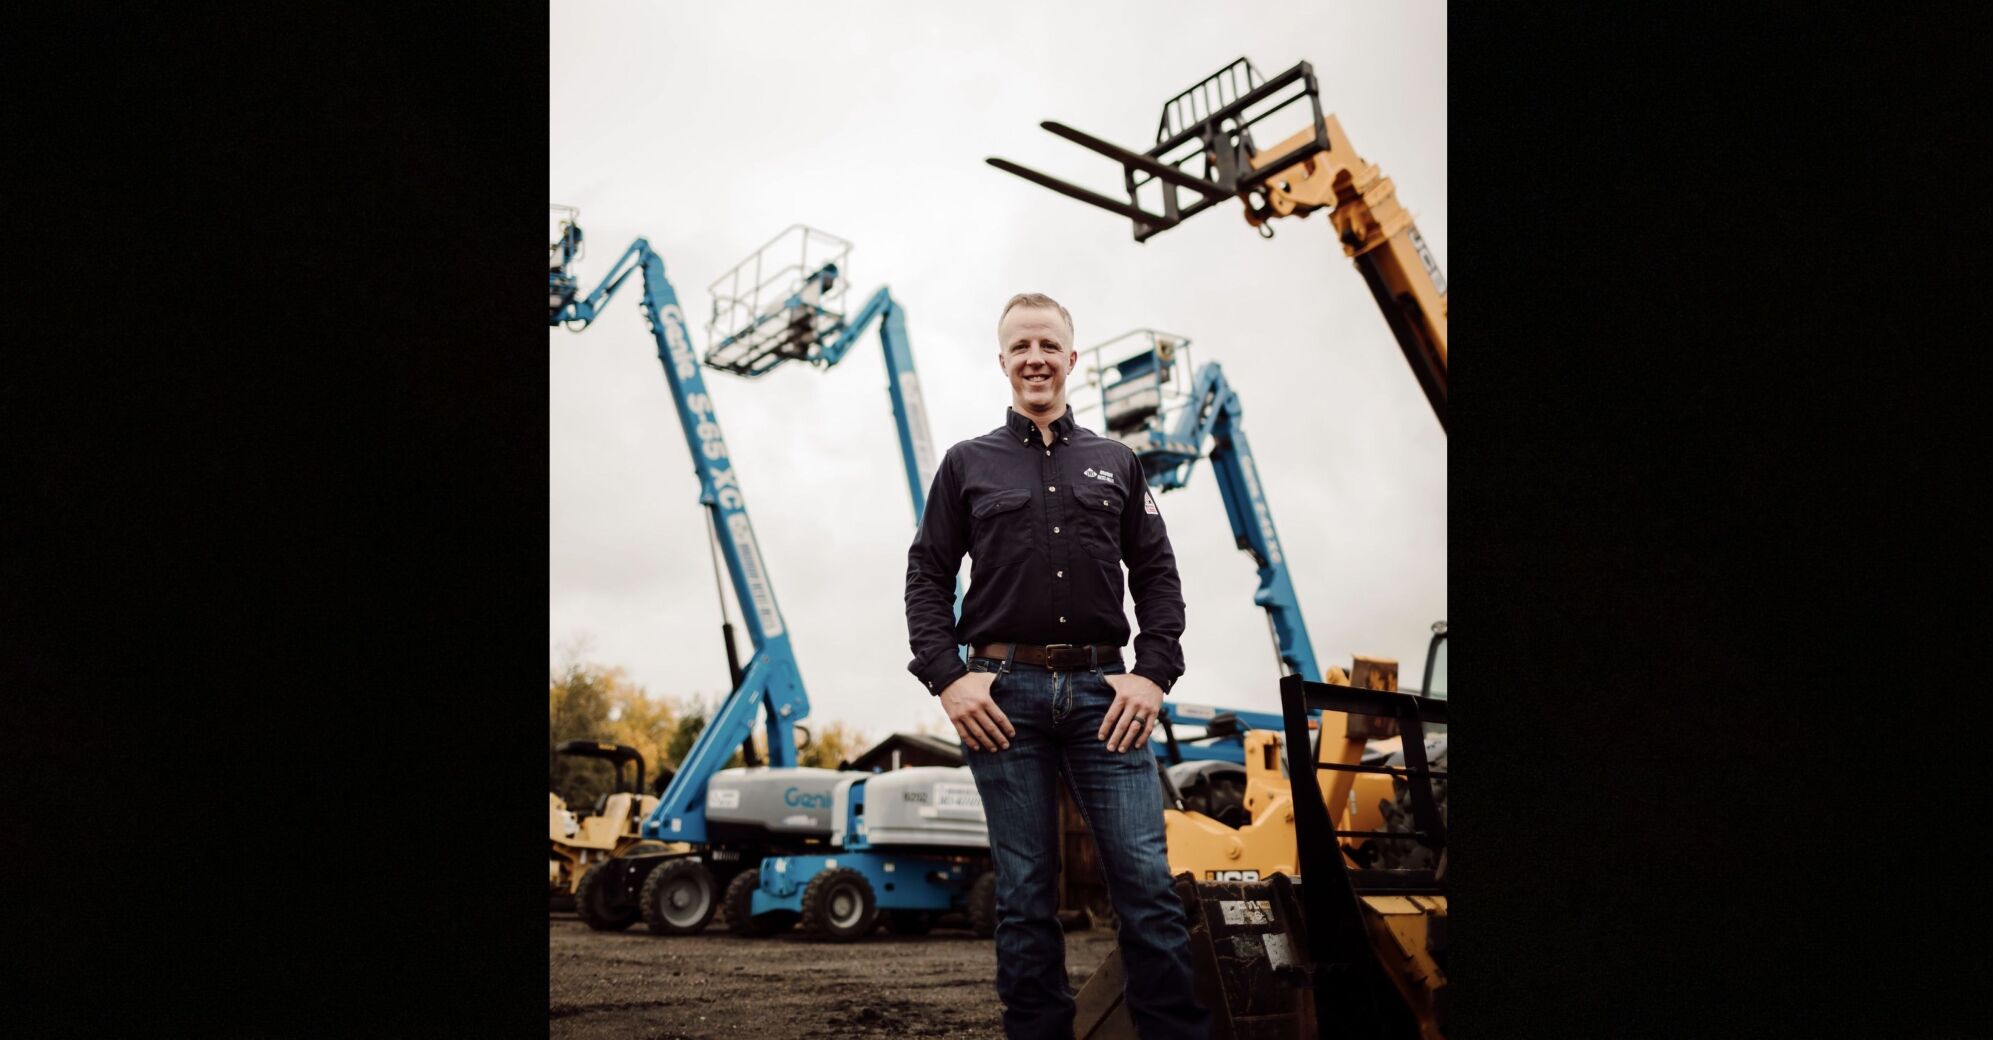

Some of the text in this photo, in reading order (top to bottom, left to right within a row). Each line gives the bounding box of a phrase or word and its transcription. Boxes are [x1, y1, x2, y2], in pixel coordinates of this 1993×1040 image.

[661, 304, 695, 383] Genie
[687, 393, 728, 461] S-65
[709, 466, 743, 509] XC
[784, 787, 833, 808] Geni
